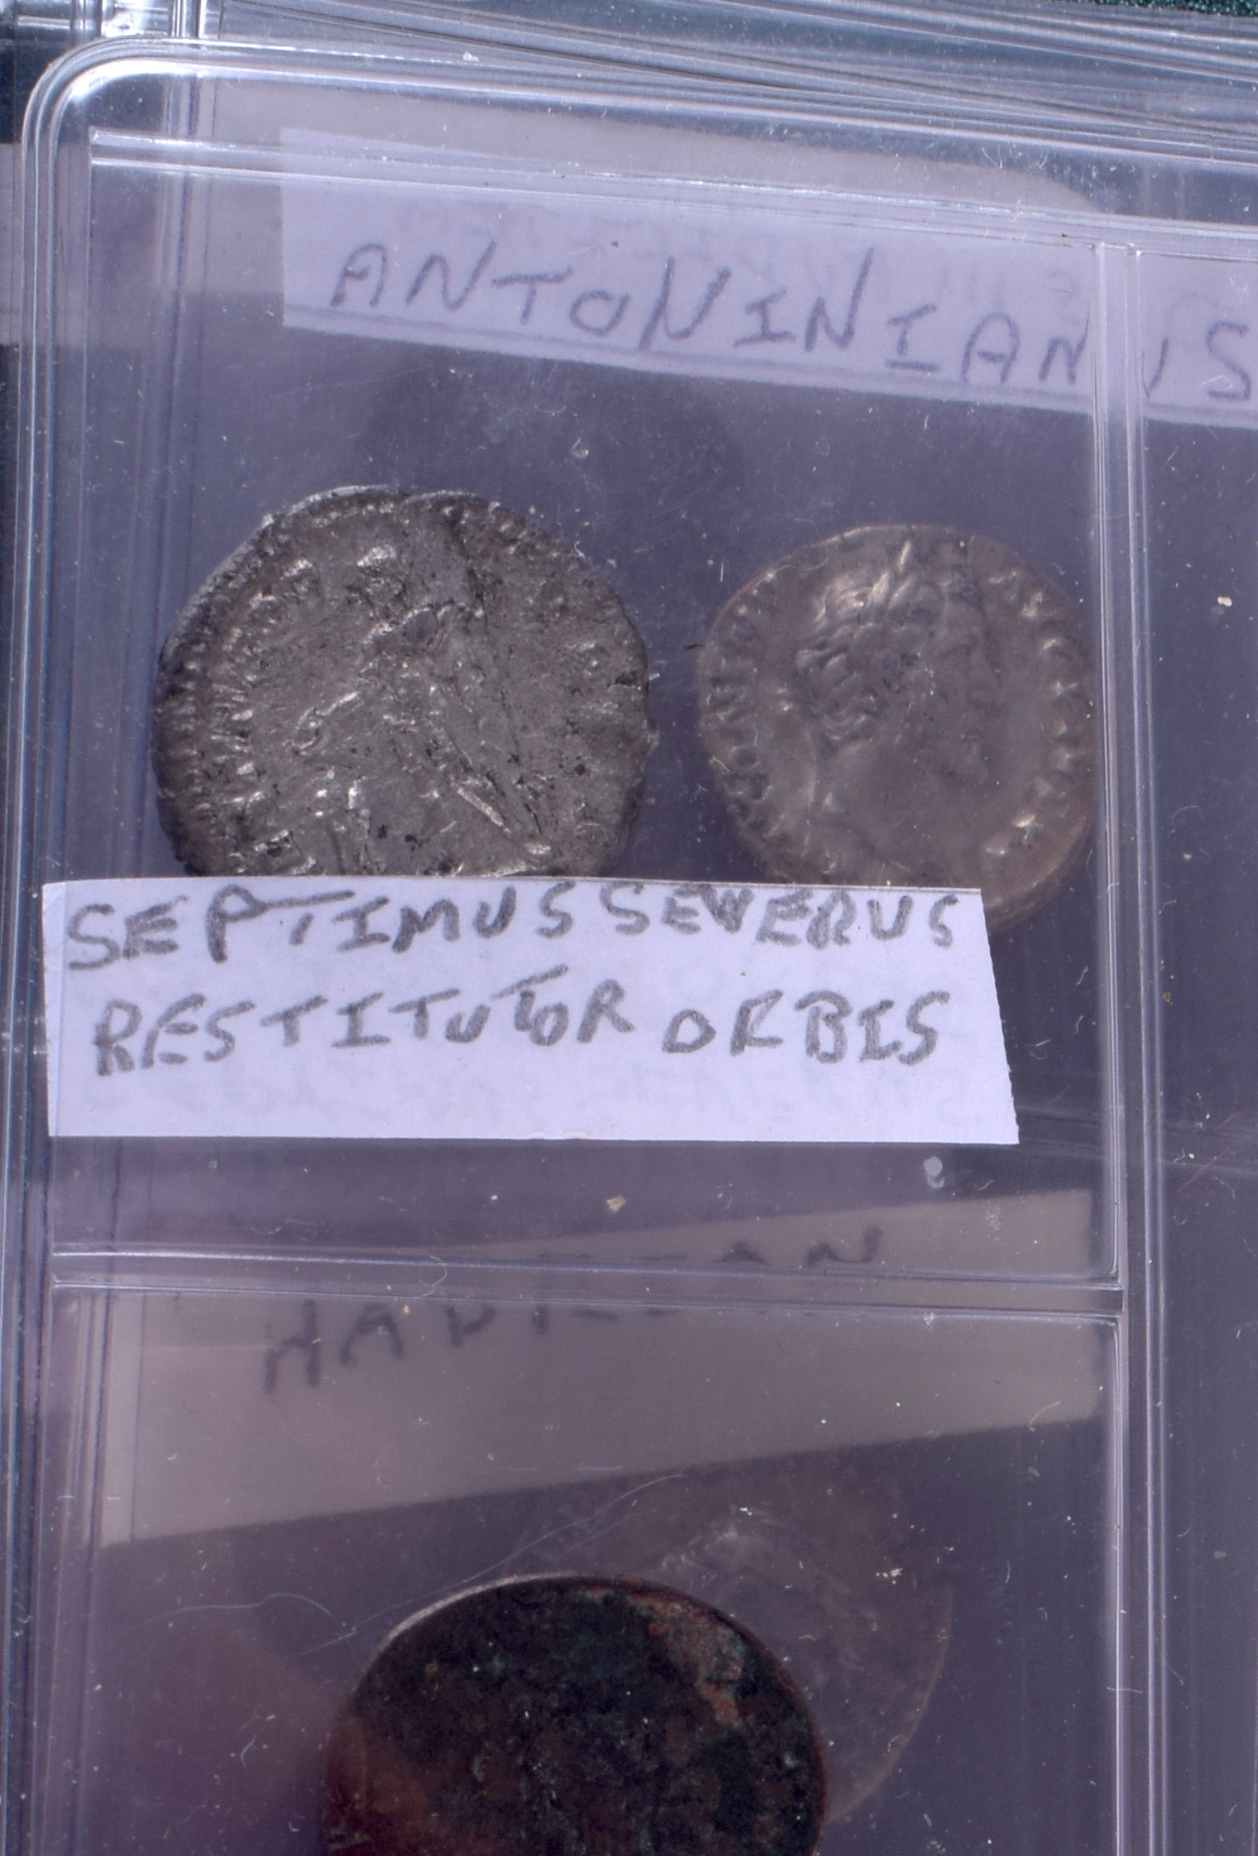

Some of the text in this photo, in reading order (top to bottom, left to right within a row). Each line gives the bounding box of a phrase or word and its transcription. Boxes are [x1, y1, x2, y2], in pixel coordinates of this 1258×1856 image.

[68, 883, 576, 971] SEPTIMUS
[94, 963, 951, 1077] RESTITUTOR ORBIS
